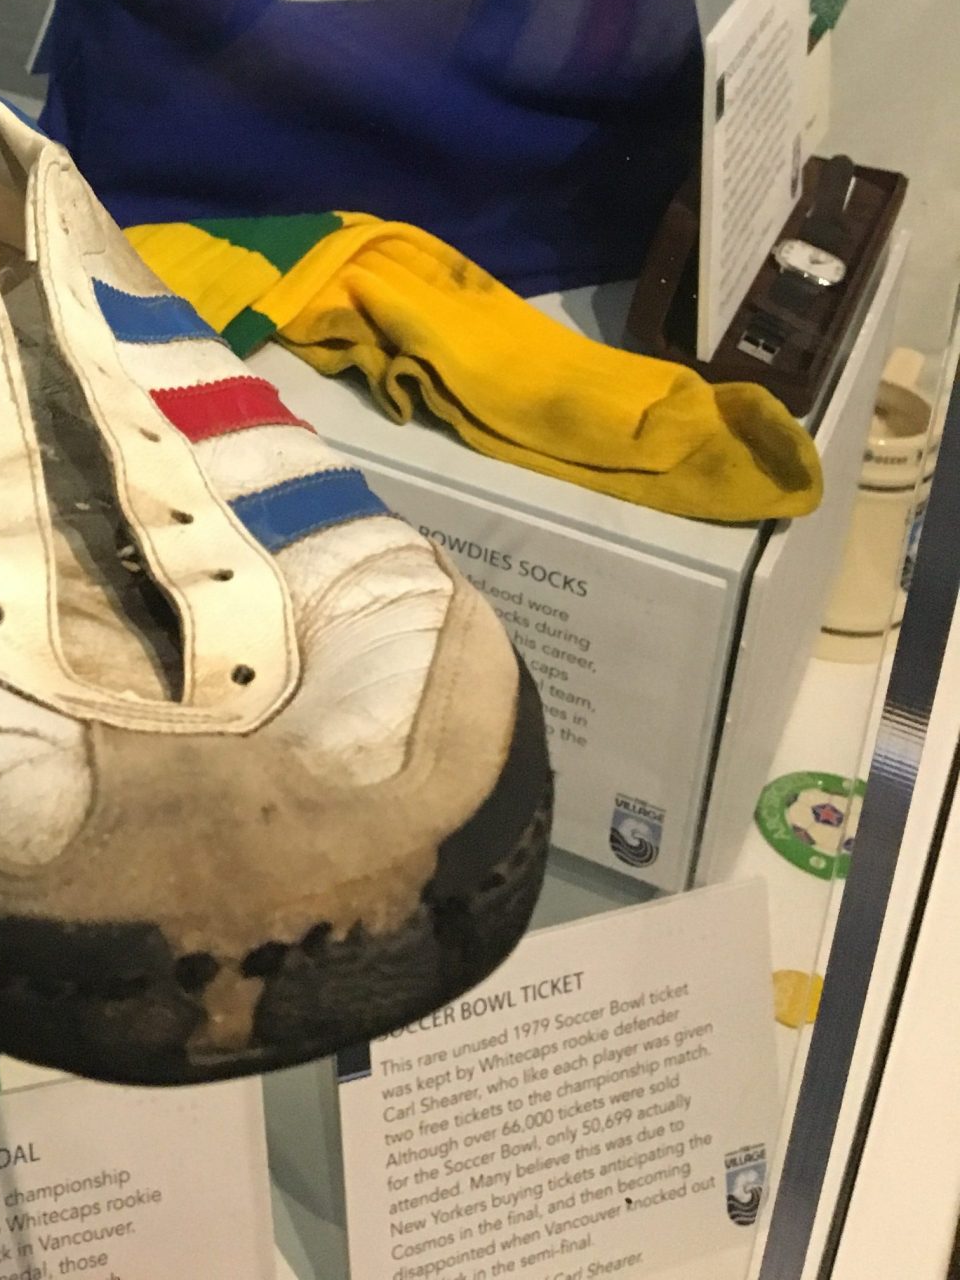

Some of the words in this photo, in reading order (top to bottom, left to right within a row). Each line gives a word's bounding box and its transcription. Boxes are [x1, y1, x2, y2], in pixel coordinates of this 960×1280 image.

[418, 525, 513, 571] ROWDIES
[518, 560, 589, 597] SOCKS
[495, 607, 530, 628] ocks
[535, 621, 591, 652] during
[528, 599, 570, 622] wore
[514, 630, 537, 650] his
[542, 642, 597, 673] career,
[530, 658, 569, 681] caps
[549, 684, 596, 713] team,
[572, 712, 588, 728] in
[560, 726, 588, 747] the
[460, 991, 516, 1020] BOWL
[520, 972, 583, 1003] TICKET
[380, 1059, 412, 1076] This
[417, 1050, 447, 1067] rare
[452, 1028, 508, 1058] unused
[514, 1018, 550, 1039] 1979
[554, 1008, 604, 1030] Soccer
[609, 992, 645, 1016] Bowl
[649, 983, 688, 1005] ticket
[381, 1083, 412, 1100] was
[416, 1070, 451, 1091] kept
[455, 1065, 474, 1082] by
[479, 1042, 558, 1073] Whitecaps
[562, 1029, 608, 1050] rookie
[613, 1009, 679, 1037] defender
[382, 1101, 416, 1123] Carl
[419, 1088, 482, 1114] Shearer,
[486, 1077, 518, 1094] who
[523, 1067, 549, 1084] like
[552, 1054, 587, 1075] each
[592, 1044, 638, 1069] player
[642, 1035, 670, 1051] was
[674, 1023, 713, 1047] given
[384, 1129, 414, 1146] two
[418, 1120, 449, 1136] free
[453, 1104, 503, 1127] tickets
[507, 1098, 524, 1112] to
[527, 1090, 552, 1106] the
[555, 1061, 659, 1098] championship
[663, 1044, 711, 1068] match.
[385, 1137, 458, 1169] Although
[462, 1129, 496, 1147] over
[500, 1109, 554, 1136] 66,000
[557, 1098, 605, 1120] tickets
[609, 1087, 644, 1105] were
[648, 1073, 680, 1095] sold
[386, 1176, 408, 1192] for
[413, 1168, 439, 1184] the
[442, 1152, 495, 1176] Soccer
[500, 1135, 541, 1159] Bowl,
[545, 1126, 577, 1146] only
[581, 1108, 632, 1136] 50,699
[636, 1094, 691, 1120] actually
[4, 1170, 131, 1207] championship
[388, 1181, 464, 1215] attended.
[468, 1171, 511, 1191] Many
[515, 1153, 570, 1178] believe
[574, 1144, 601, 1160] this
[604, 1135, 633, 1151] was
[636, 1126, 665, 1142] due
[668, 1120, 685, 1133] to
[389, 1219, 426, 1237] New
[430, 1201, 487, 1224] Yorkers
[490, 1184, 543, 1208] buying
[547, 1169, 595, 1191] tickets
[599, 1142, 684, 1176] anticipating
[688, 1134, 712, 1150] the
[5, 1202, 100, 1238] Whitecaps
[106, 1188, 161, 1212] rookie
[390, 1233, 455, 1260] Cosmos
[458, 1227, 473, 1240] in
[476, 1219, 503, 1235] the
[507, 1204, 542, 1226] final,
[547, 1193, 575, 1214] and
[579, 1186, 613, 1204] then
[617, 1162, 691, 1194] becoming
[392, 1240, 496, 1280] disappointed
[499, 1230, 541, 1251] when
[544, 1206, 621, 1236] Vancouver
[625, 1182, 687, 1211] knocked
[691, 1176, 715, 1193] out
[17, 1240, 33, 1258] in
[38, 1221, 136, 1251] Vancouver.
[58, 1253, 108, 1274] those
[472, 1269, 487, 1280] in
[491, 1260, 515, 1277] the
